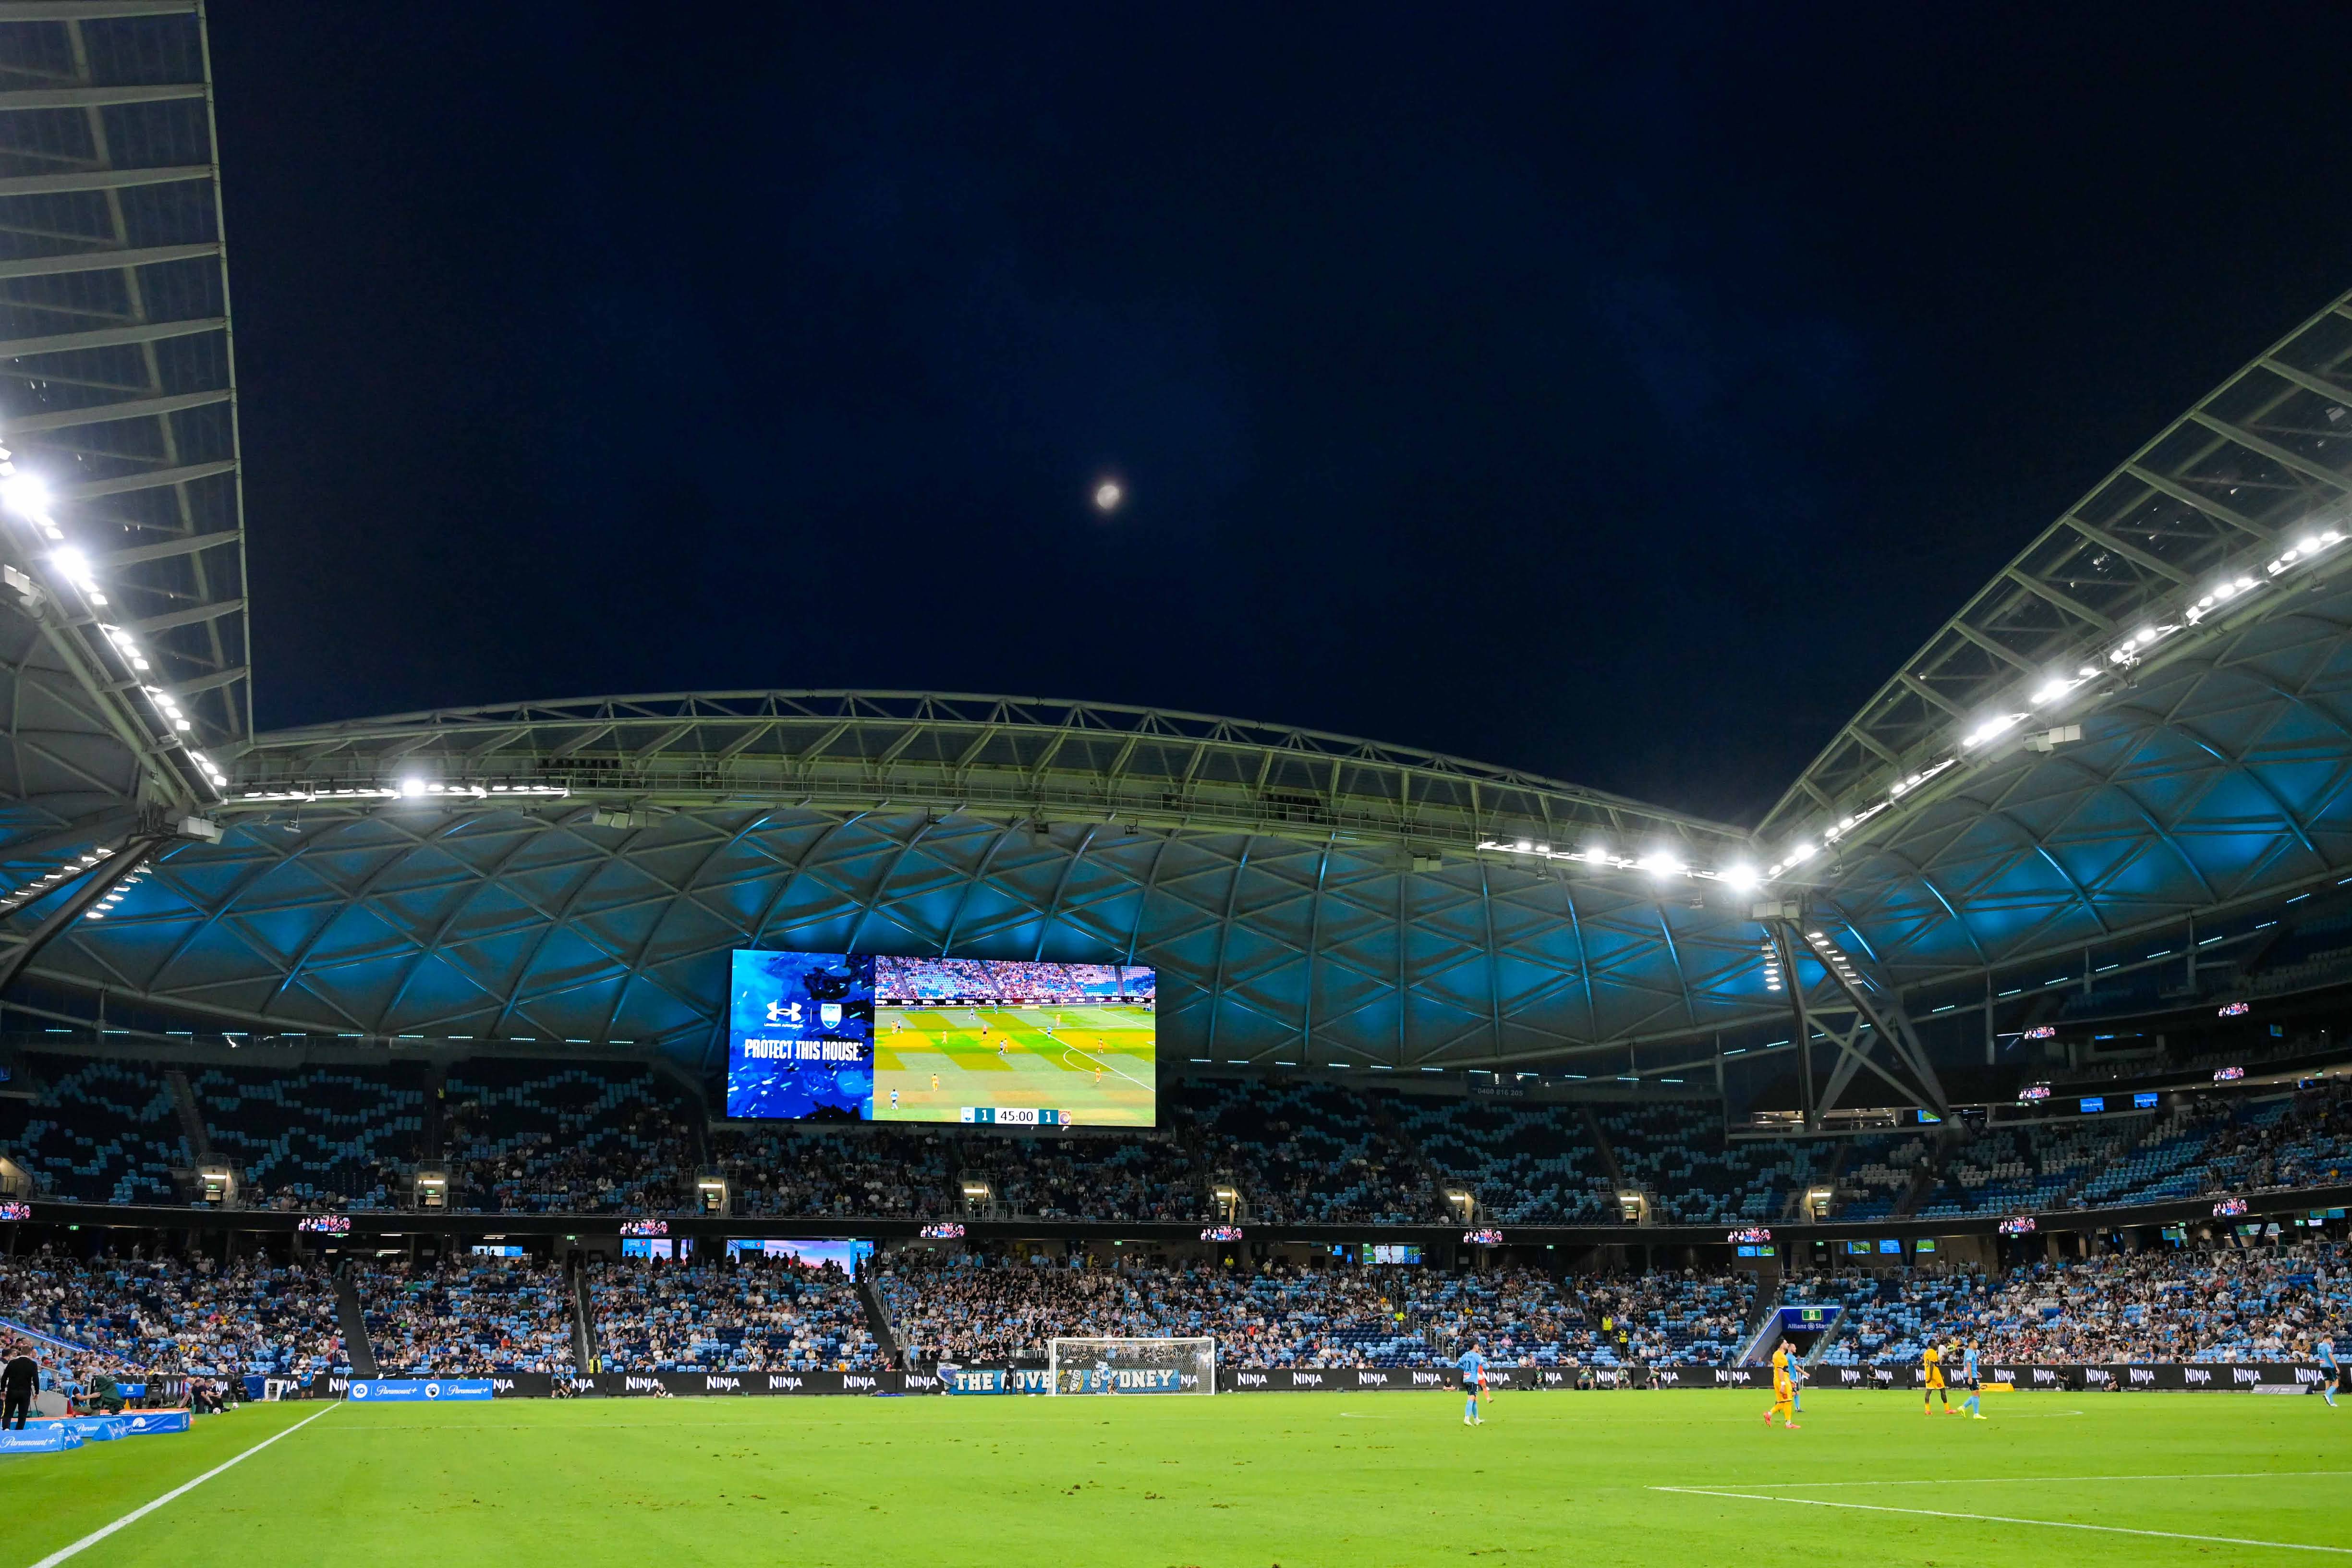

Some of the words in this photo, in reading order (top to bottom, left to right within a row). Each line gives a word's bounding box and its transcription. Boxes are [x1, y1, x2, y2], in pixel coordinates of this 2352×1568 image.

[745, 1039, 793, 1059] PROTECT
[795, 1040, 820, 1060] THIS
[982, 1109, 988, 1121] 1
[1001, 1111, 1033, 1122] 45:00
[1045, 1111, 1052, 1123] 1
[769, 1375, 802, 1391] NINJA
[844, 1374, 876, 1390] NINJA
[906, 1374, 938, 1390] NINJA
[956, 1373, 994, 1390] THE
[1180, 1374, 1199, 1387] NJA
[1237, 1373, 1267, 1387] NINJA
[1293, 1372, 1322, 1387] NINJA
[1359, 1372, 1388, 1386] NINJA
[1413, 1371, 1441, 1386] NINJA
[1483, 1372, 1510, 1385] NINJA
[1546, 1372, 1563, 1385] NJA
[1661, 1372, 1679, 1384] NJA
[1841, 1369, 1861, 1384] NINJA
[1875, 1369, 1893, 1384] NINJA
[1994, 1368, 2016, 1383] NINJA
[2033, 1368, 2055, 1384] NINJA
[2086, 1368, 2110, 1385] NINJA
[2130, 1368, 2155, 1385] NINJA
[2184, 1367, 2211, 1386] NINJA
[2233, 1367, 2261, 1386] NINJA
[2295, 1367, 2324, 1386] NINJA
[215, 1381, 228, 1395] NJA
[329, 1377, 350, 1392] NIN
[492, 1379, 514, 1393] NJA
[571, 1378, 594, 1393] NJA
[626, 1376, 658, 1392] NINJA
[707, 1375, 740, 1392] NINJA
